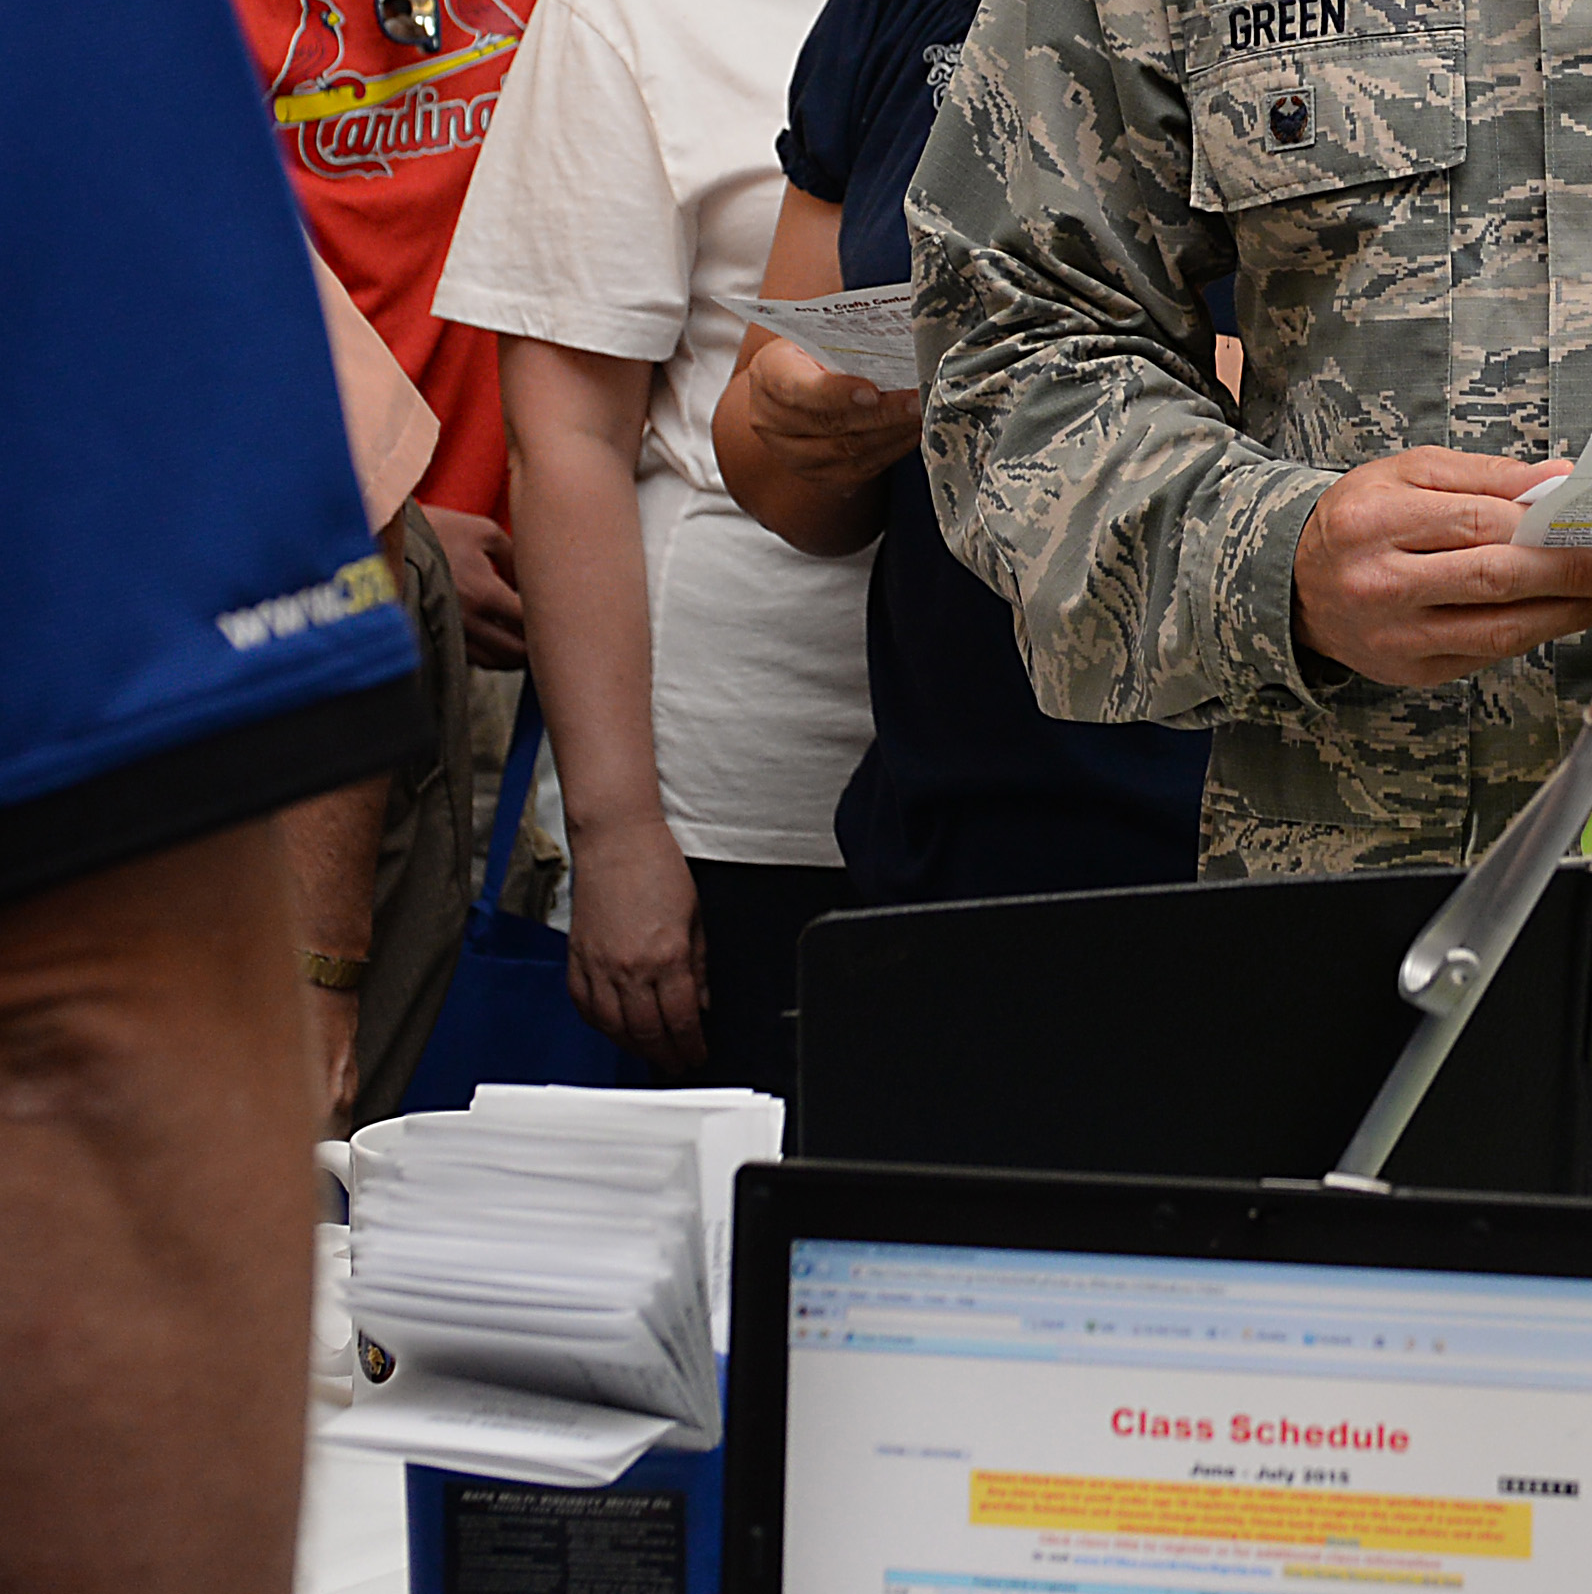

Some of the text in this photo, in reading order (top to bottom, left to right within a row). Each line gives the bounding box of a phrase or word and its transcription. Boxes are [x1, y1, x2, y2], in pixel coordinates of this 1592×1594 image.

[834, 301, 871, 311] Crafts
[1110, 1406, 1411, 1454] Class Schedule
[1255, 1465, 1295, 1488] July
